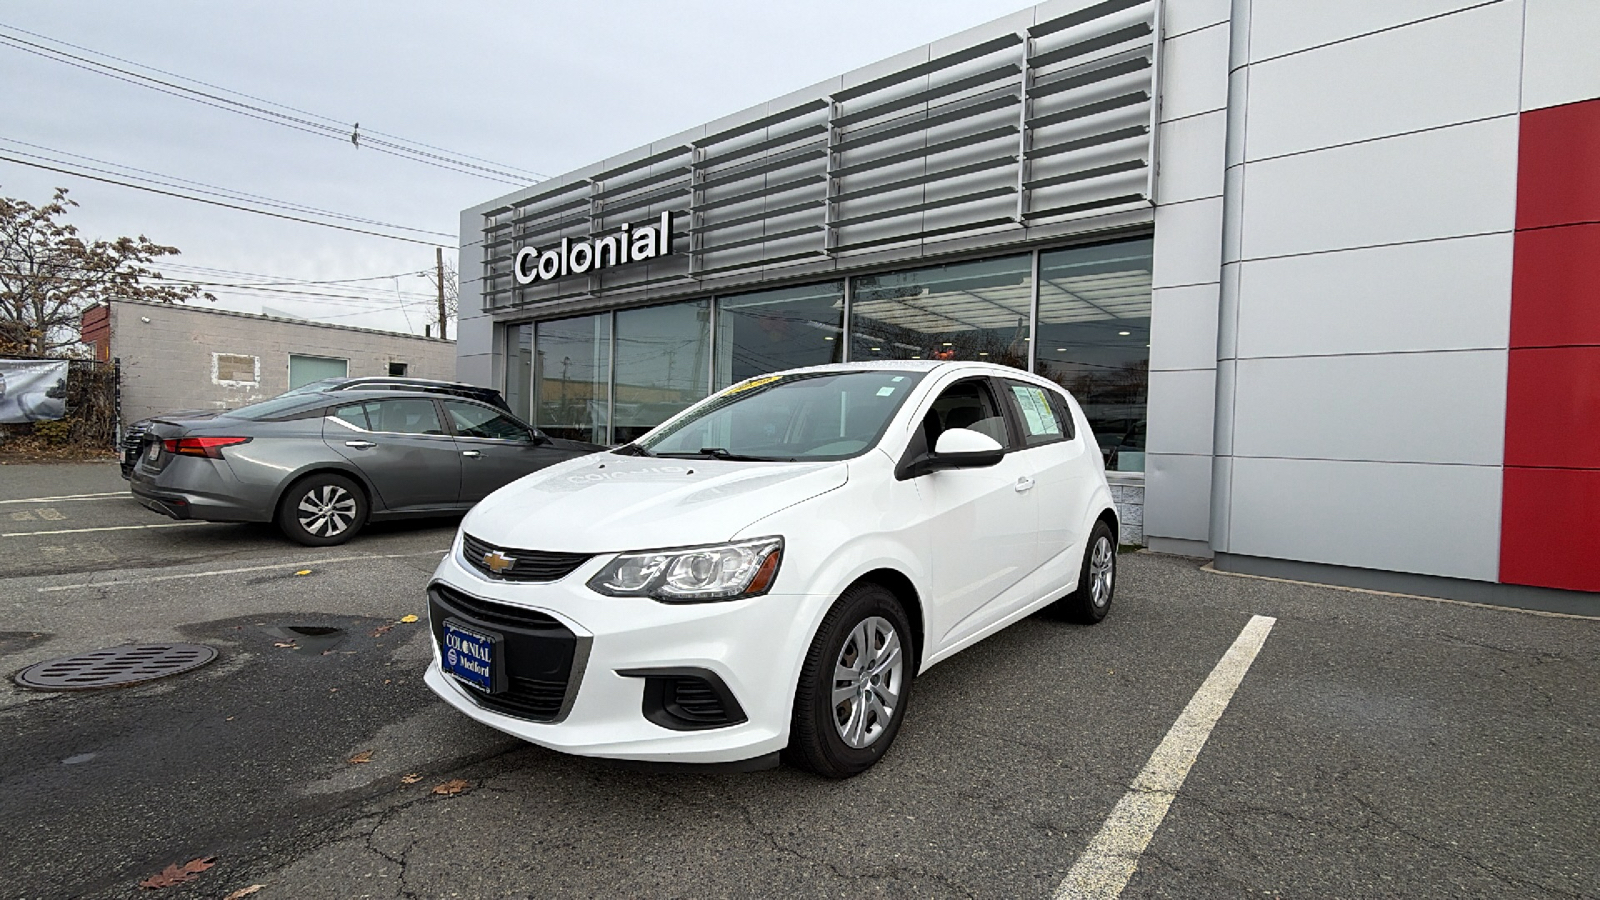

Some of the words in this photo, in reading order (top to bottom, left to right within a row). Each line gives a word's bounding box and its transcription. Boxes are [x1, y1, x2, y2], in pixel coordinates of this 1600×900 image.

[514, 210, 672, 284] Colonial
[446, 634, 491, 662] COLONIAL
[460, 656, 489, 677] Medford
